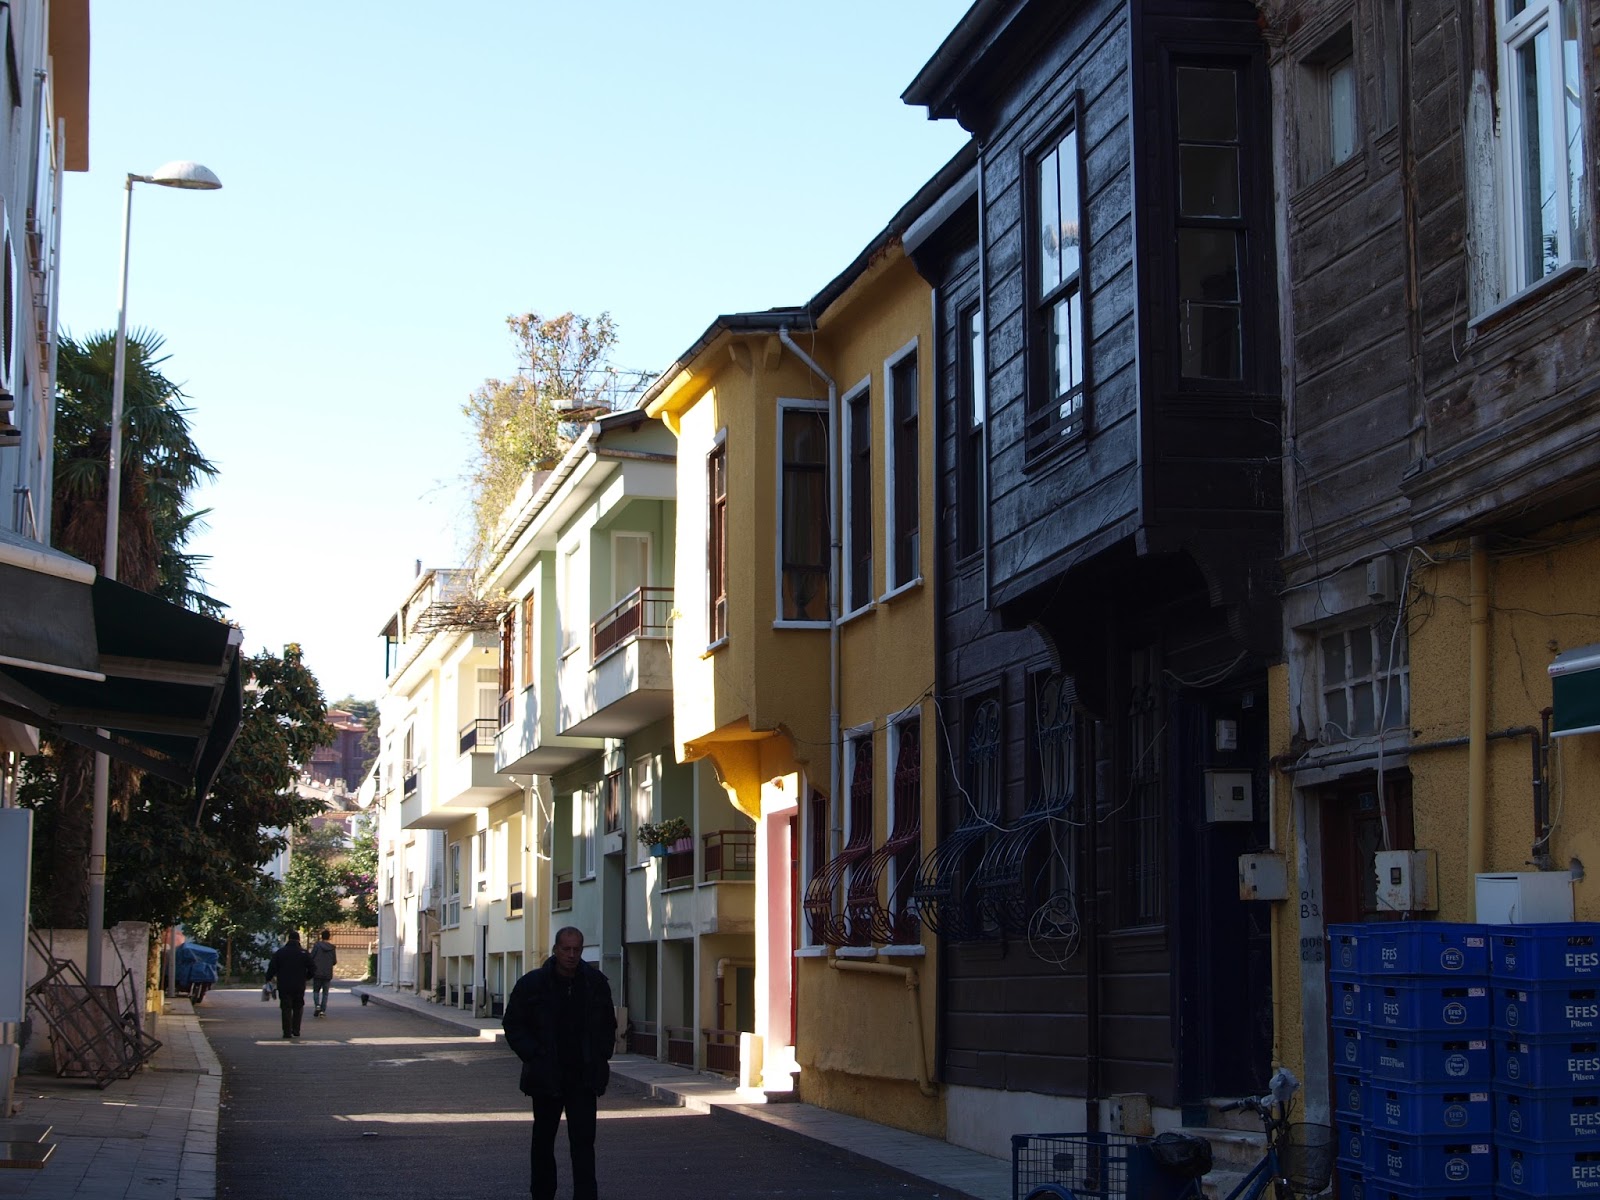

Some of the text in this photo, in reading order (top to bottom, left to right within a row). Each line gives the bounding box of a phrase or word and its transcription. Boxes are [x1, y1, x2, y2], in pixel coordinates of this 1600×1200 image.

[1382, 948, 1397, 960] EFES
[1565, 953, 1599, 967] EFES
[1383, 1003, 1399, 1016] EFES
[1565, 1005, 1598, 1018] EFES
[1570, 1019, 1593, 1028] Pilsen
[1568, 1058, 1600, 1072] EFES
[1572, 1073, 1595, 1081] Pilsen
[1385, 1103, 1400, 1117] EFES
[1570, 1113, 1600, 1126] EFES
[1575, 1128, 1597, 1136] Pilsen
[1387, 1154, 1402, 1169] EFES
[1577, 1181, 1599, 1189] Pilsen
